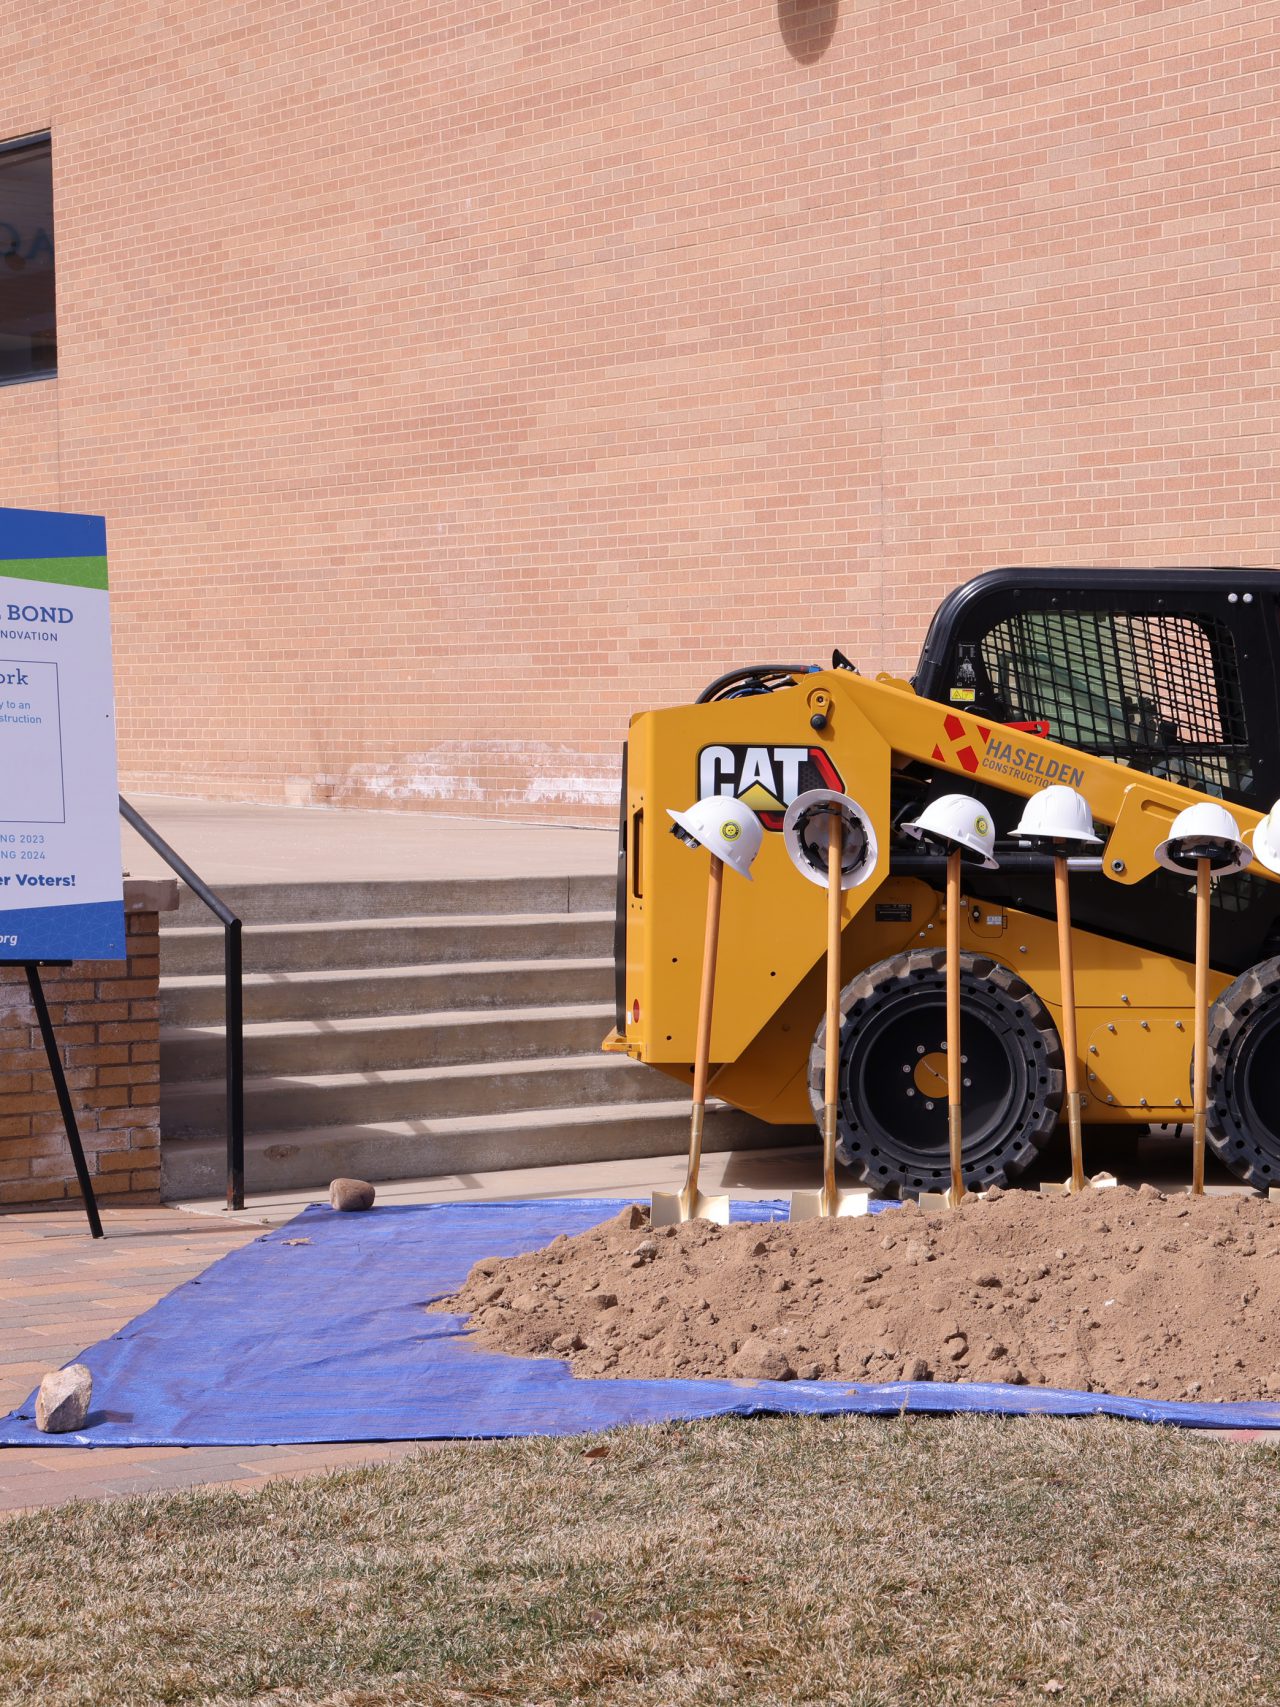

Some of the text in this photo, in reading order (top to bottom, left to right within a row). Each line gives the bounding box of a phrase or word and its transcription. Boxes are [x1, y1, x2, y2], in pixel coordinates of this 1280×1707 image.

[7, 604, 74, 624] BOND
[0, 630, 58, 641] NOVATION
[6, 700, 16, 709] to
[19, 702, 31, 710] an
[985, 738, 1085, 788] HASELDEN
[700, 746, 809, 808] CAT
[0, 834, 45, 844] NG 2023
[0, 850, 46, 860] NG 2024
[16, 874, 76, 887] Voters!
